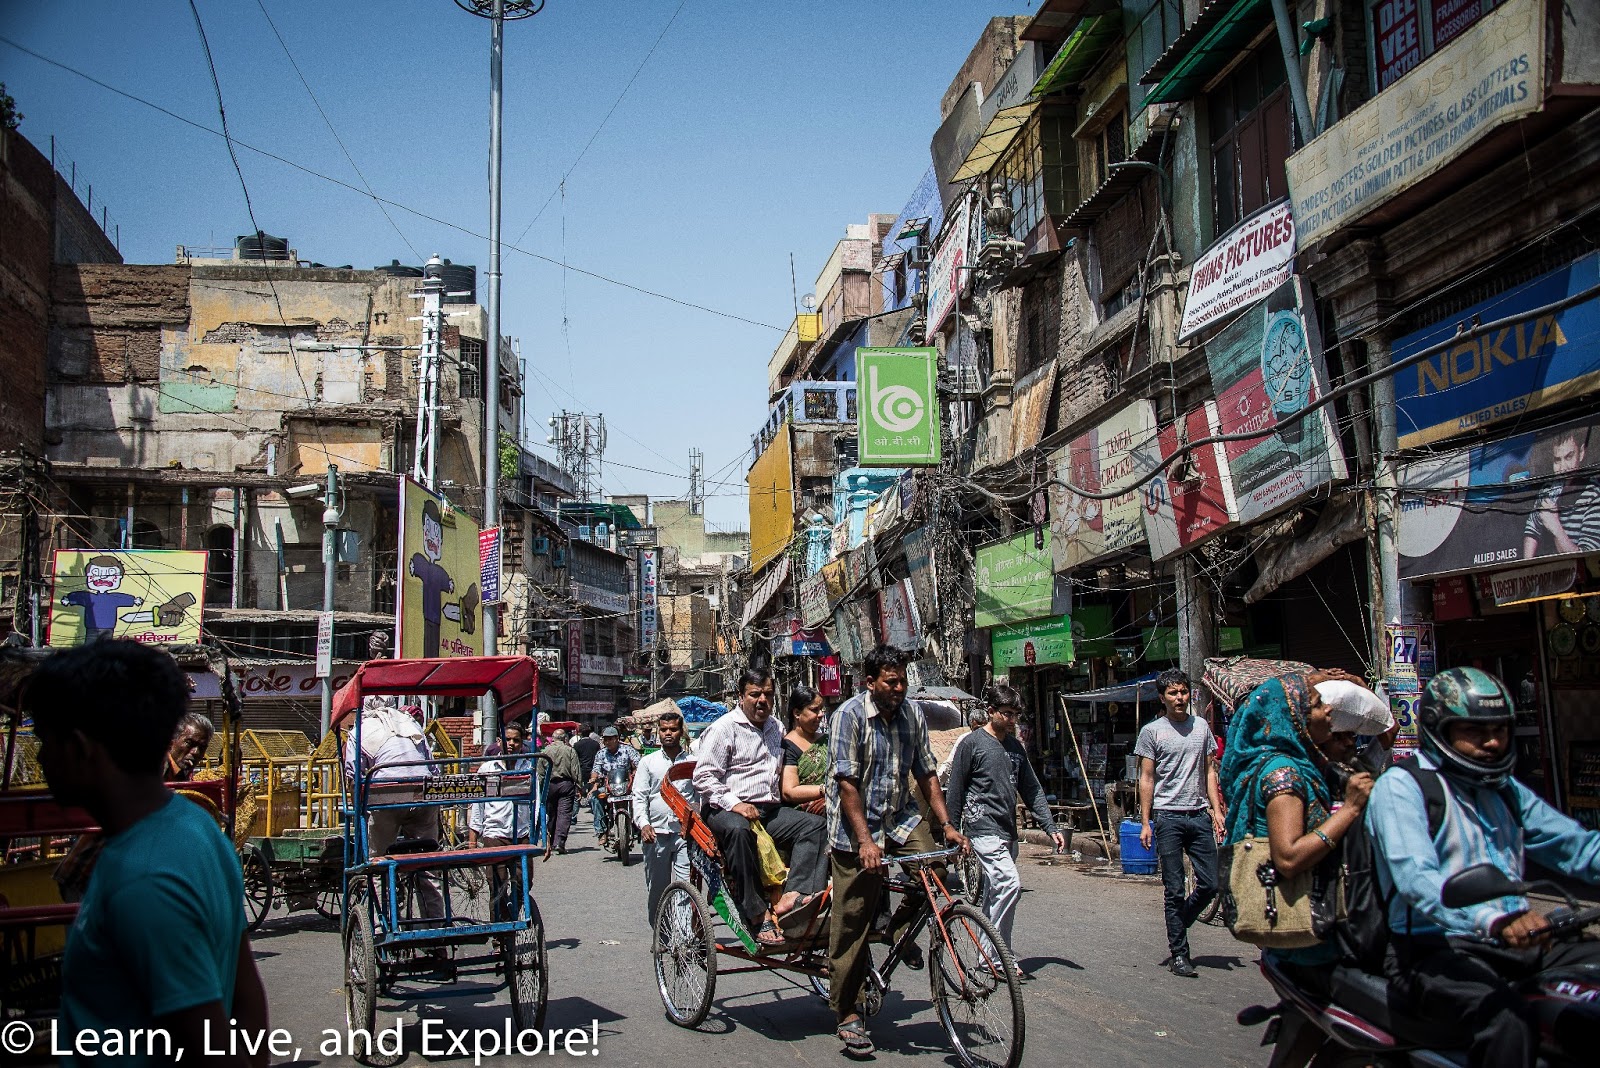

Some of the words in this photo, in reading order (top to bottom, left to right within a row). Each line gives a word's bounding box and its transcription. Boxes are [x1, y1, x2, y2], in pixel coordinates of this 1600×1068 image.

[1381, 18, 1417, 65] VEE
[1436, 1, 1480, 43] ACCESSORIES
[1366, 142, 1402, 174] GOLDEN
[1447, 88, 1477, 125] GLASS
[1417, 150, 1423, 167] &
[1426, 134, 1449, 161] OTHER
[1477, 81, 1528, 121] MATERIALS
[1191, 251, 1224, 297] TWINS
[1225, 213, 1292, 274] PICTURES
[1417, 314, 1568, 397] NOKIA
[1458, 408, 1490, 430] ALLIED
[1494, 399, 1526, 418] SALES
[1474, 552, 1494, 563] ALLIED
[1496, 548, 1517, 560] SALES
[1394, 636, 1417, 663] 27
[428, 786, 483, 794] AJANTA
